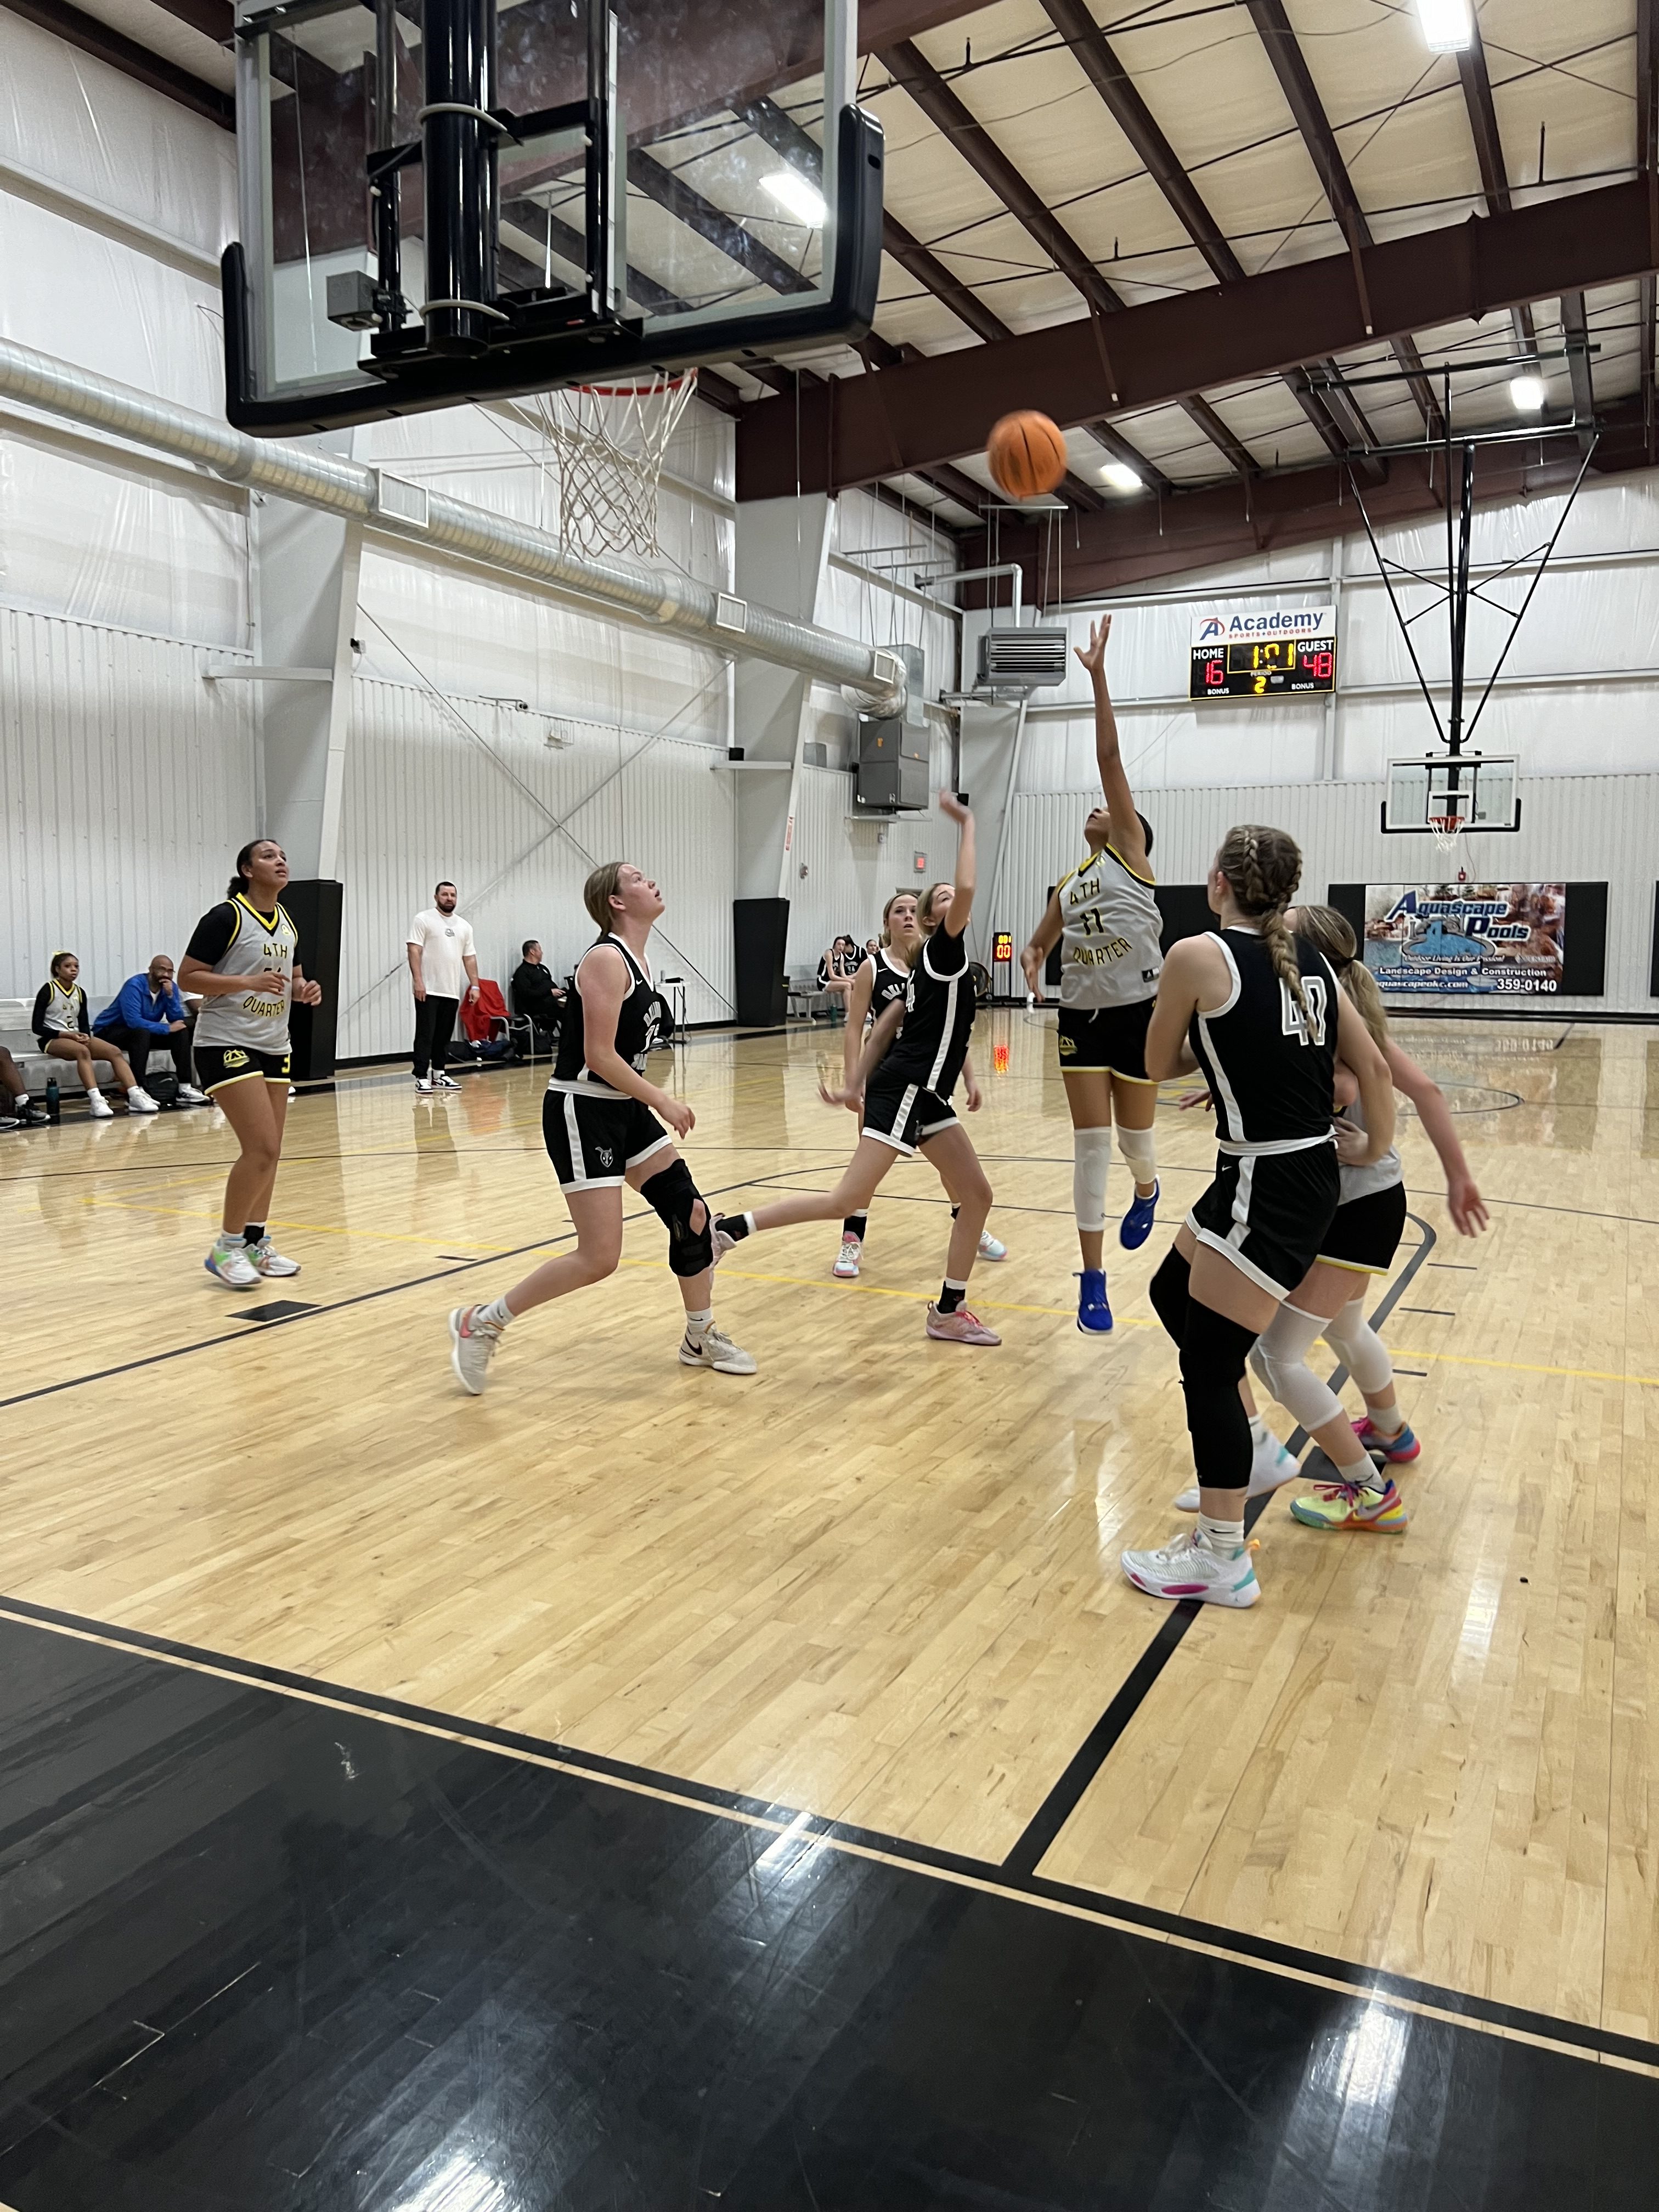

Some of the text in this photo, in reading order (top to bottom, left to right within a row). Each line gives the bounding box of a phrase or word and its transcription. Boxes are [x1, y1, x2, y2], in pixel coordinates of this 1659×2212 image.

[1229, 612, 1323, 631] Academy
[1193, 648, 1224, 660] HOME
[1297, 640, 1334, 652] GUEST
[1206, 660, 1223, 685] 16
[1303, 652, 1333, 678] 48
[1207, 687, 1229, 696] BONUS
[1255, 676, 1266, 693] 2
[1070, 877, 1101, 906] 4TH
[1386, 890, 1508, 922] Aquascape
[1465, 917, 1530, 939] Pools
[263, 943, 287, 959] 4TH
[1073, 937, 1133, 966] QUARTER
[1380, 967, 1431, 975] Landscape
[1434, 967, 1468, 977] Design
[1482, 968, 1547, 977] Construction
[1497, 978, 1557, 992] 359-0140
[243, 995, 285, 1017] QUARTER
